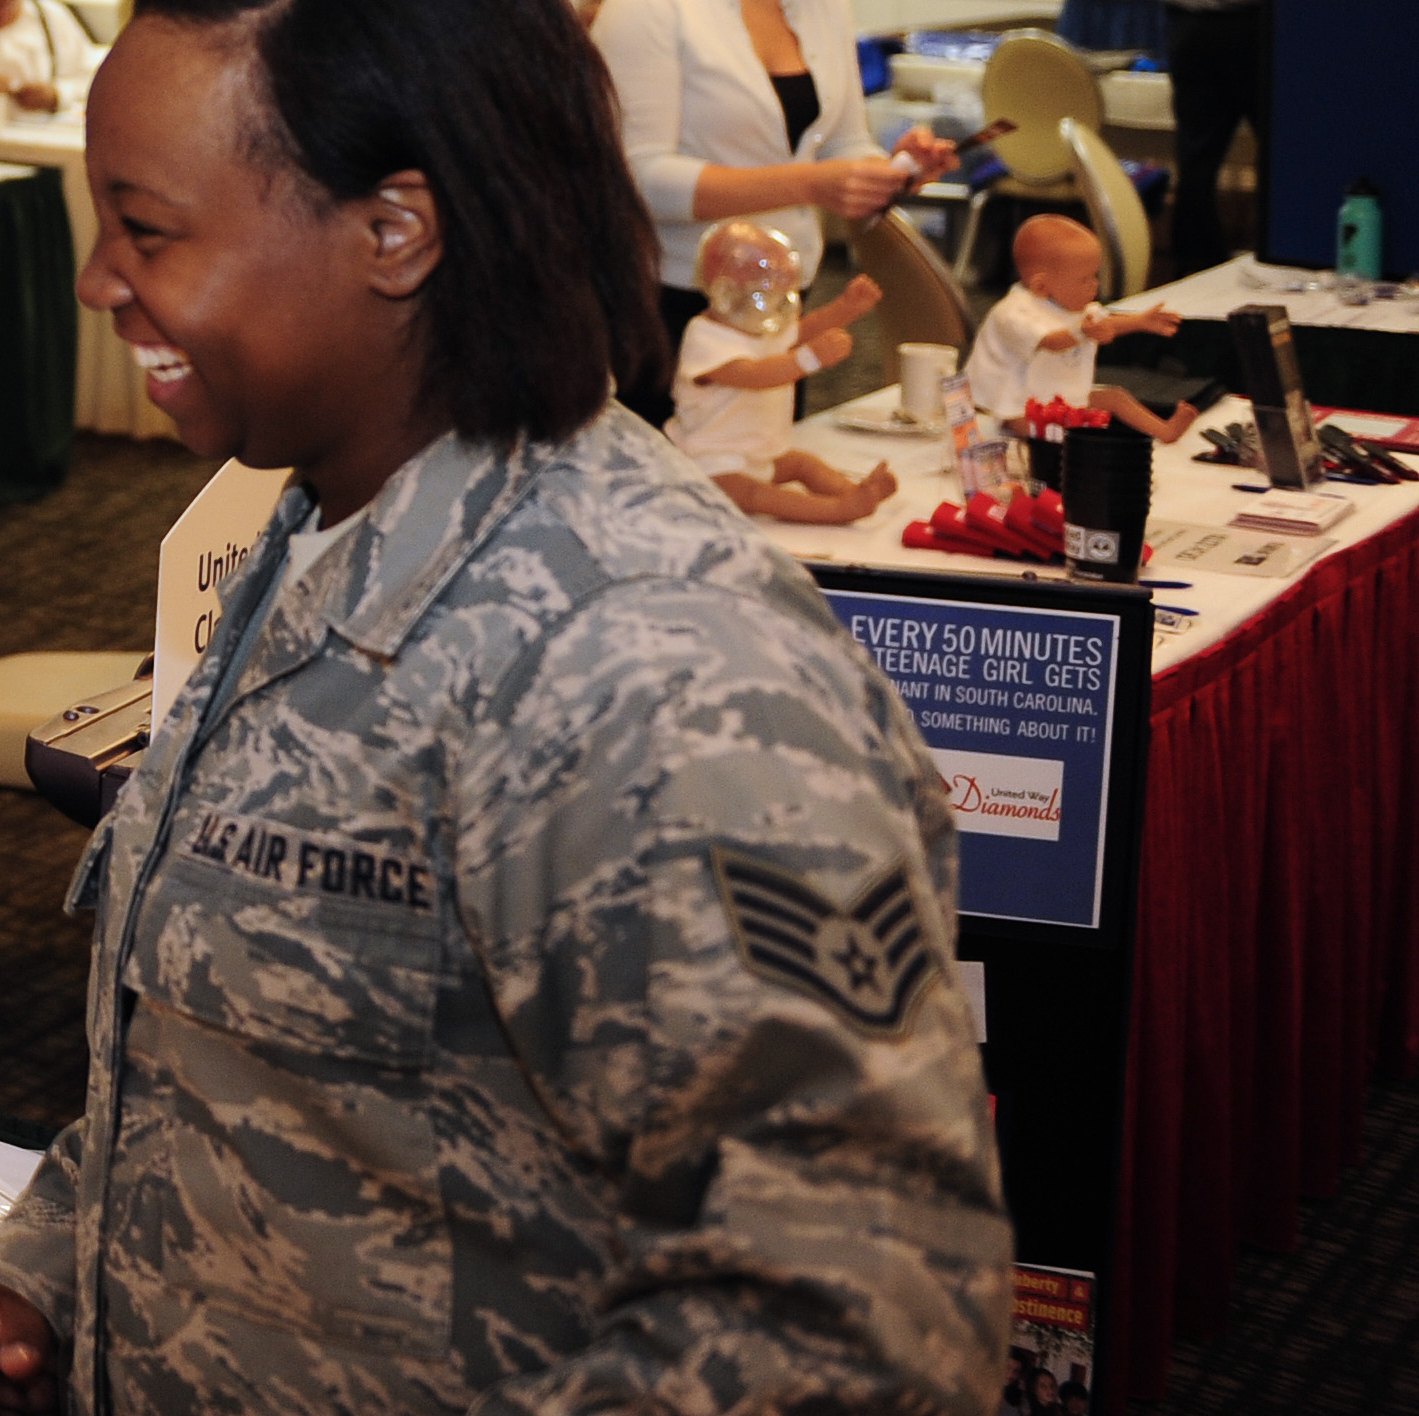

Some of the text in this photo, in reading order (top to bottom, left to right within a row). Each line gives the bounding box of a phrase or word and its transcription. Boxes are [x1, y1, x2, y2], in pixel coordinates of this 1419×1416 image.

[198, 531, 262, 592] Unite
[852, 615, 1103, 666] EVERY 50 MINUTES
[874, 646, 1101, 690] TEENAGE GIRL GETS
[891, 679, 1098, 716] NANT IN SOUTH CAROLINA.
[921, 711, 1010, 736] SOMETHING
[1017, 720, 1069, 741] ABOUT
[1076, 727, 1096, 744] IT!
[951, 774, 1061, 822] Diamonds
[991, 787, 1050, 804] United Way
[236, 827, 288, 882] AIR
[298, 840, 431, 909] FORCE
